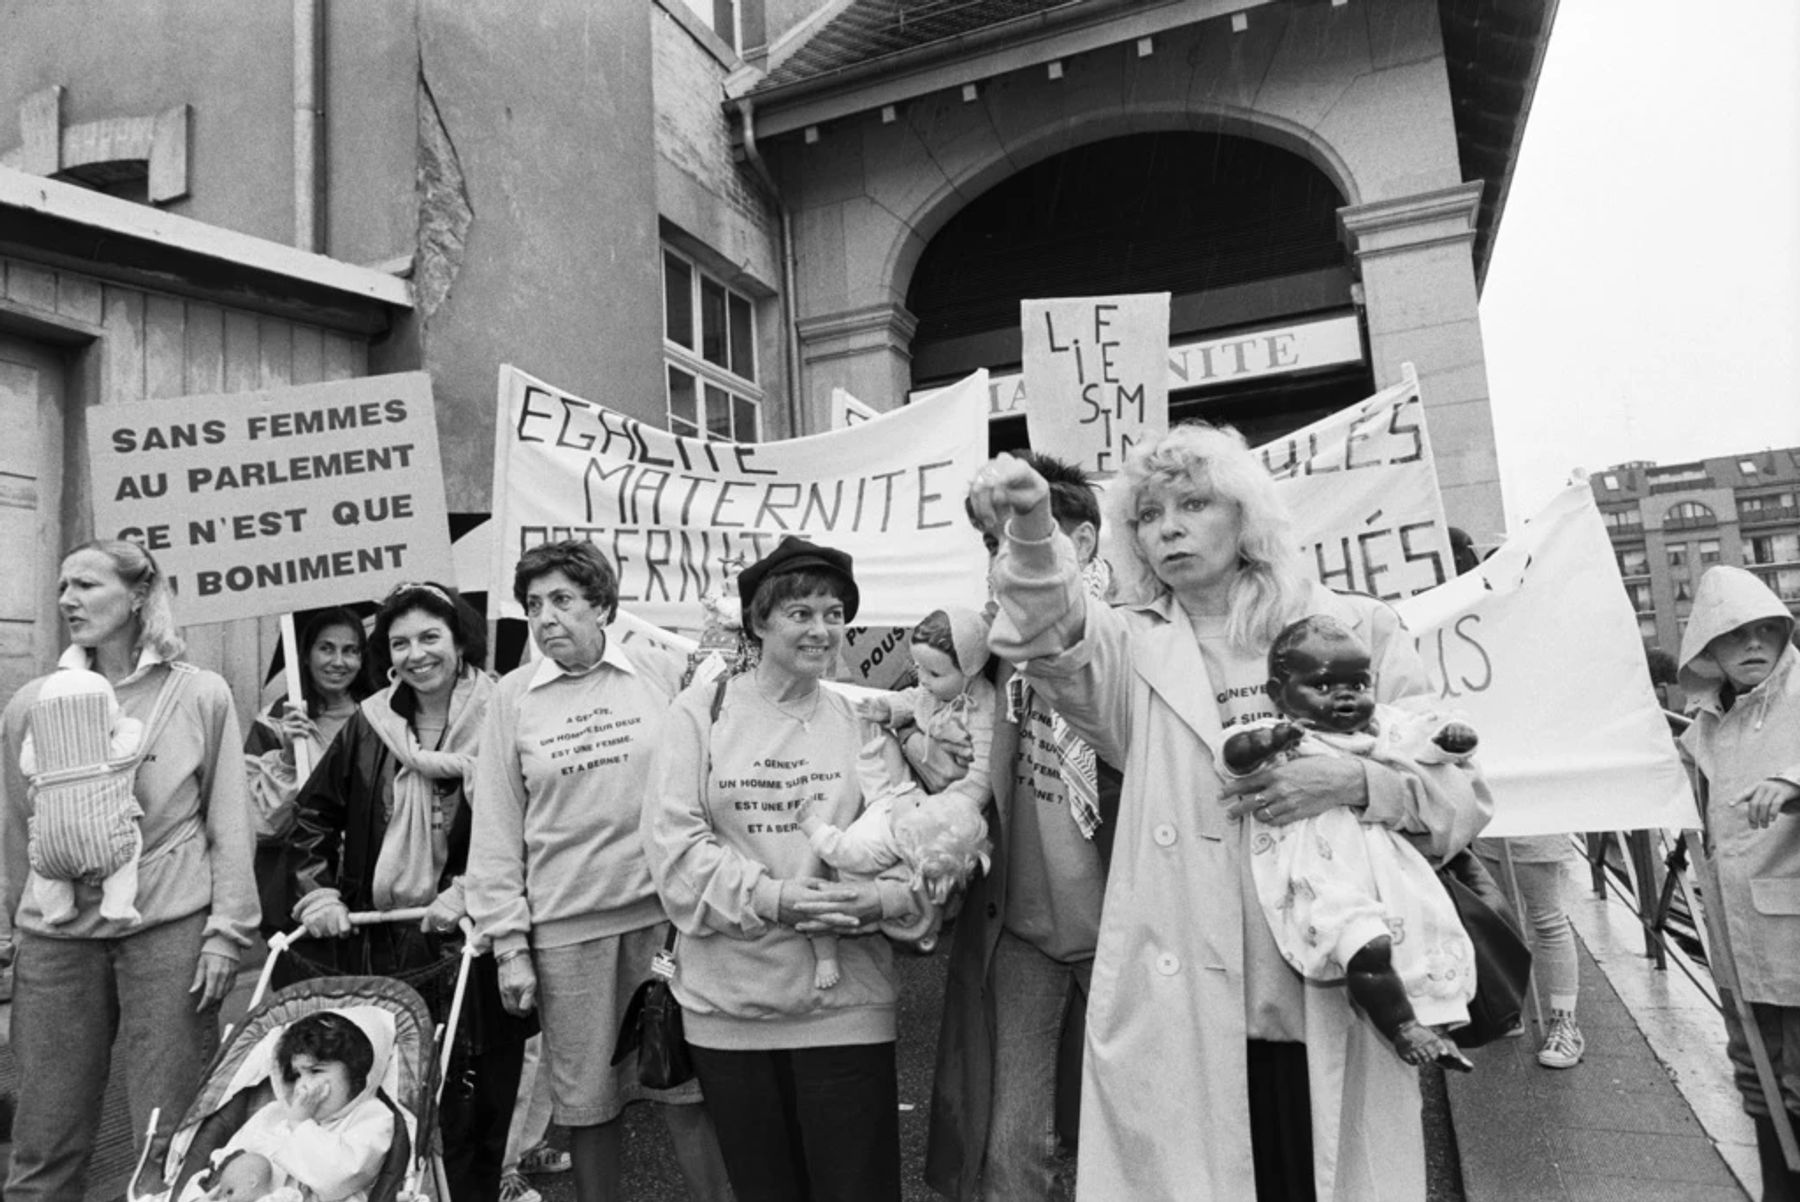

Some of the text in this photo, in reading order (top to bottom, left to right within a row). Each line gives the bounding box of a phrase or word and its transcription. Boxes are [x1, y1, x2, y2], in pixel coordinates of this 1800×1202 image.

[111, 399, 408, 454] SANS FEMMES
[115, 443, 415, 501] AU PARLEMENT
[583, 456, 954, 533] MATERNITE
[188, 507, 308, 546] N'EST
[331, 493, 414, 528] QUE
[197, 543, 408, 597] BONIMENT
[1300, 508, 1447, 600] HÉS
[615, 716, 642, 728] DEUX
[551, 747, 571, 760] EST
[572, 743, 594, 755] UNE
[561, 765, 574, 776] ET
[577, 763, 585, 771] A
[586, 756, 621, 770] BERNE
[718, 771, 842, 790] UN HOMME SUR DEUX
[734, 800, 759, 812] EST
[761, 801, 784, 812] UNE
[747, 823, 763, 834] ET
[765, 823, 774, 833] A
